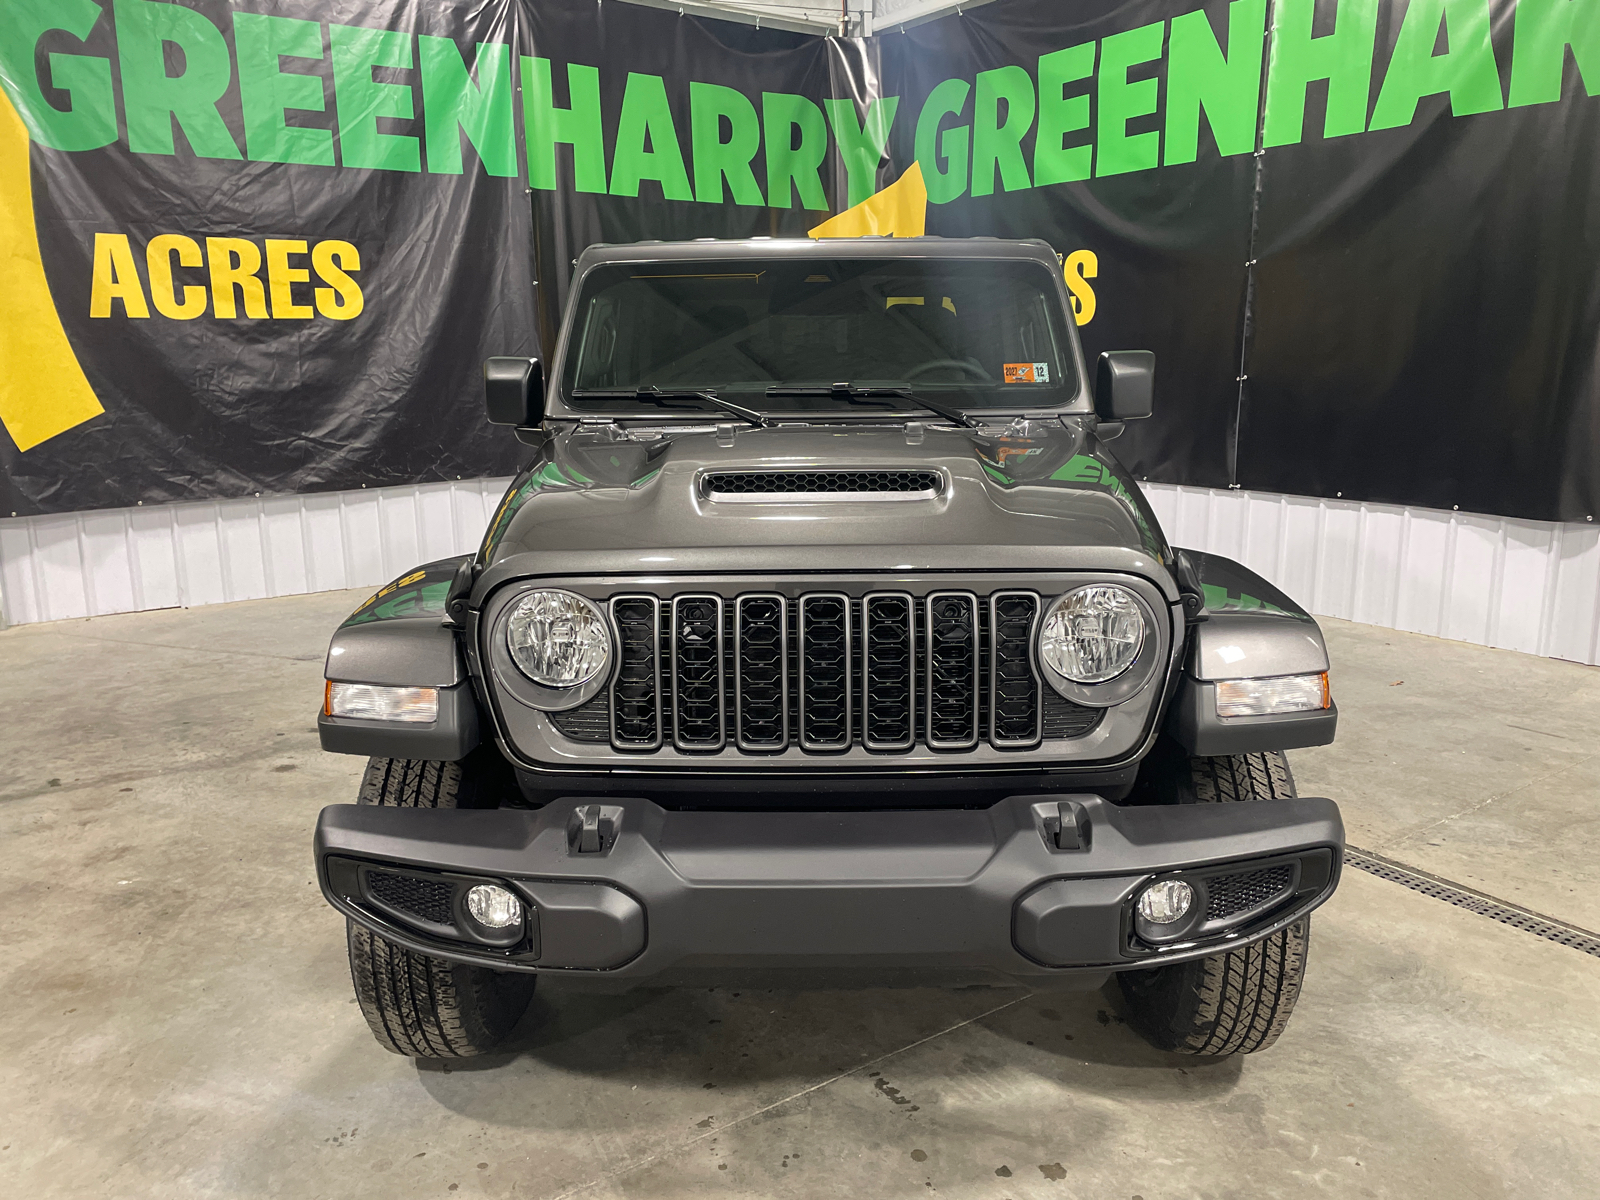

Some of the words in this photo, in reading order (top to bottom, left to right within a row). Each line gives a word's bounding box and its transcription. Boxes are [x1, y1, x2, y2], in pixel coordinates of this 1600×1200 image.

[0, 0, 518, 178] GREEN
[519, 55, 900, 211] HARRY
[914, 0, 1267, 204] GREEN
[89, 232, 365, 321] ACRES
[1035, 366, 1045, 377] 12
